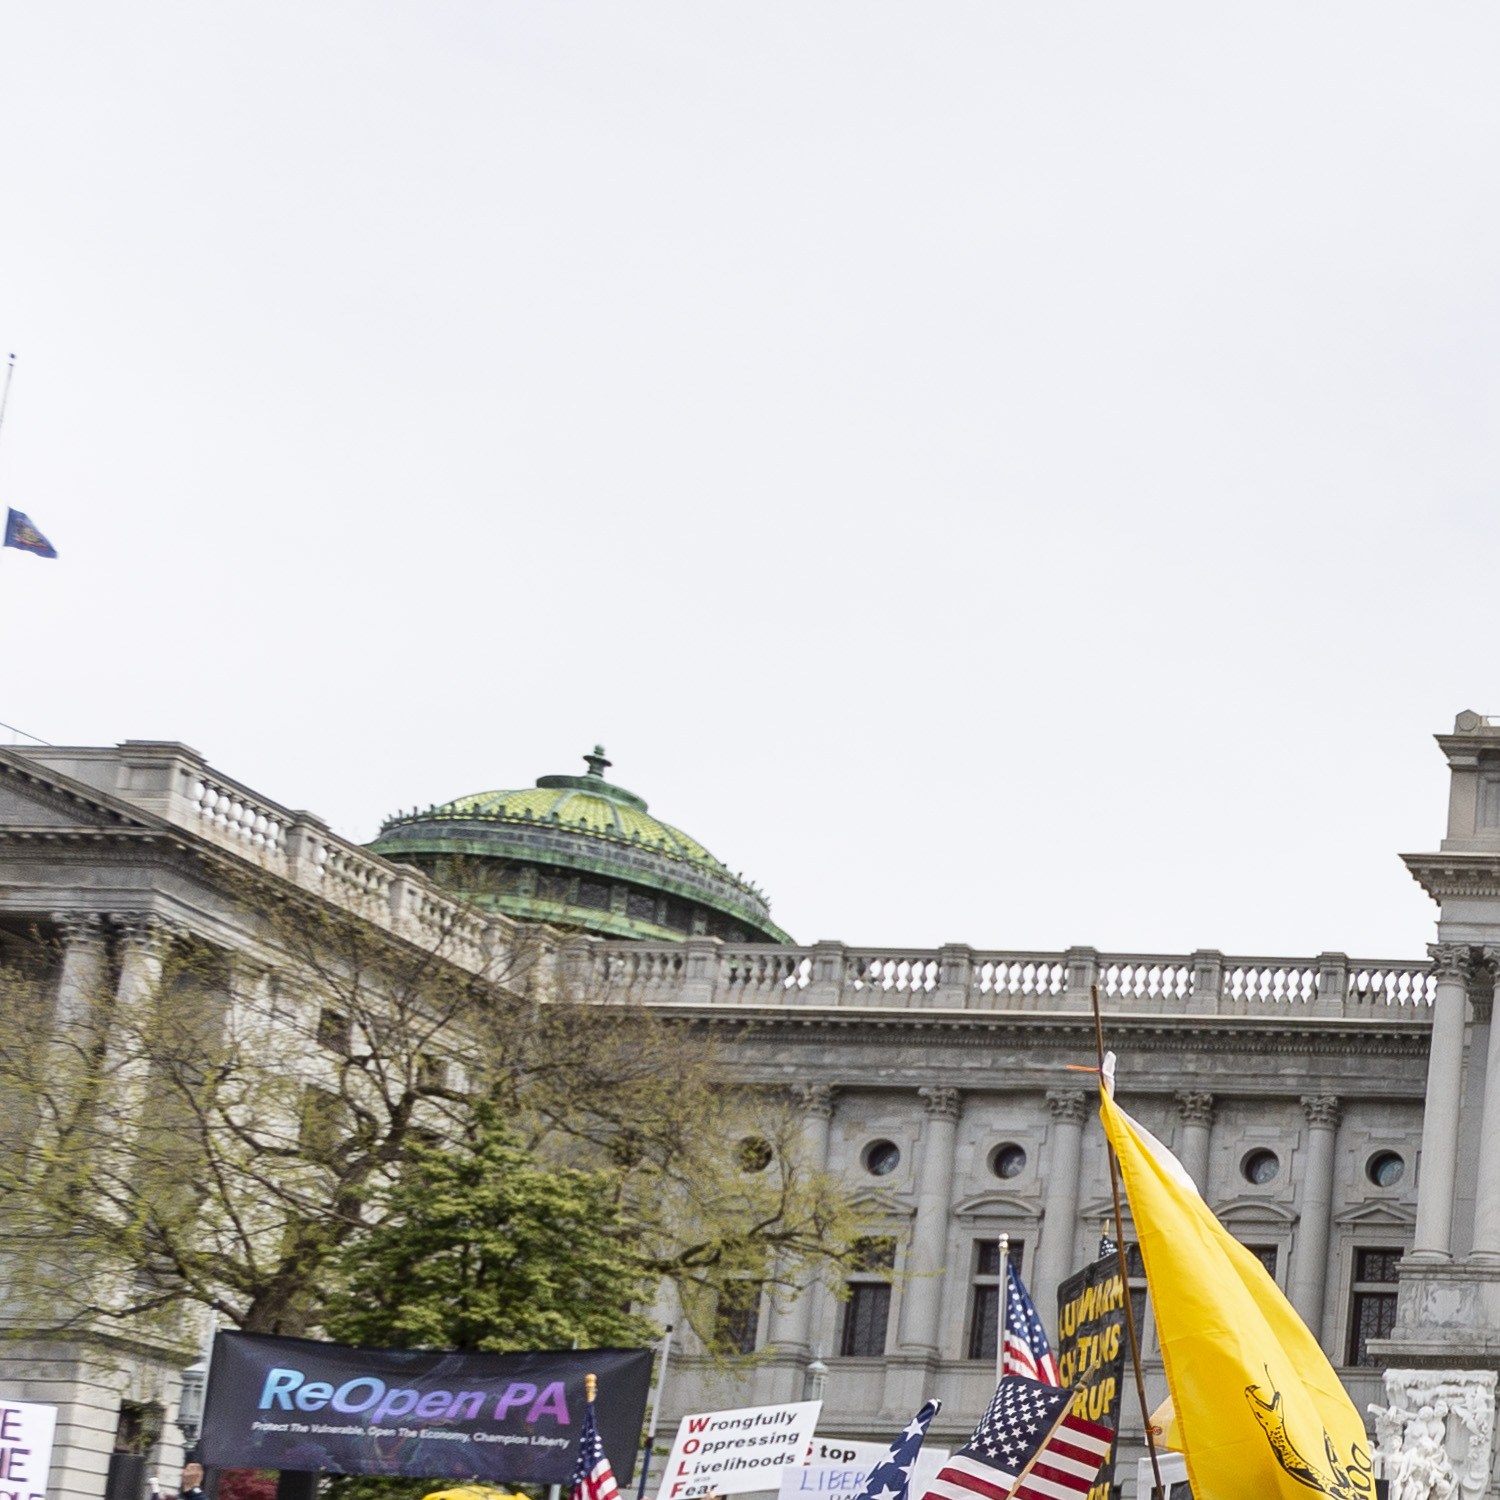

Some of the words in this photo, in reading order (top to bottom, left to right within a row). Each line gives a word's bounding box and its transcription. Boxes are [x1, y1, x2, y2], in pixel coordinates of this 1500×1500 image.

[258, 1367, 487, 1424] ReOpen
[494, 1381, 571, 1425] PA
[688, 1411, 798, 1434] Wrongfully
[251, 1421, 288, 1434] Protect
[290, 1422, 309, 1434] The
[310, 1423, 366, 1438] Vulnerable,
[367, 1425, 396, 1440] Open
[398, 1427, 418, 1439] The
[419, 1429, 472, 1444] Economy,
[473, 1431, 530, 1446] Champion
[531, 1436, 570, 1450] Liberty
[683, 1432, 799, 1455] Oppressing
[677, 1452, 796, 1477] Livelihoods
[669, 1480, 718, 1499] Fear
